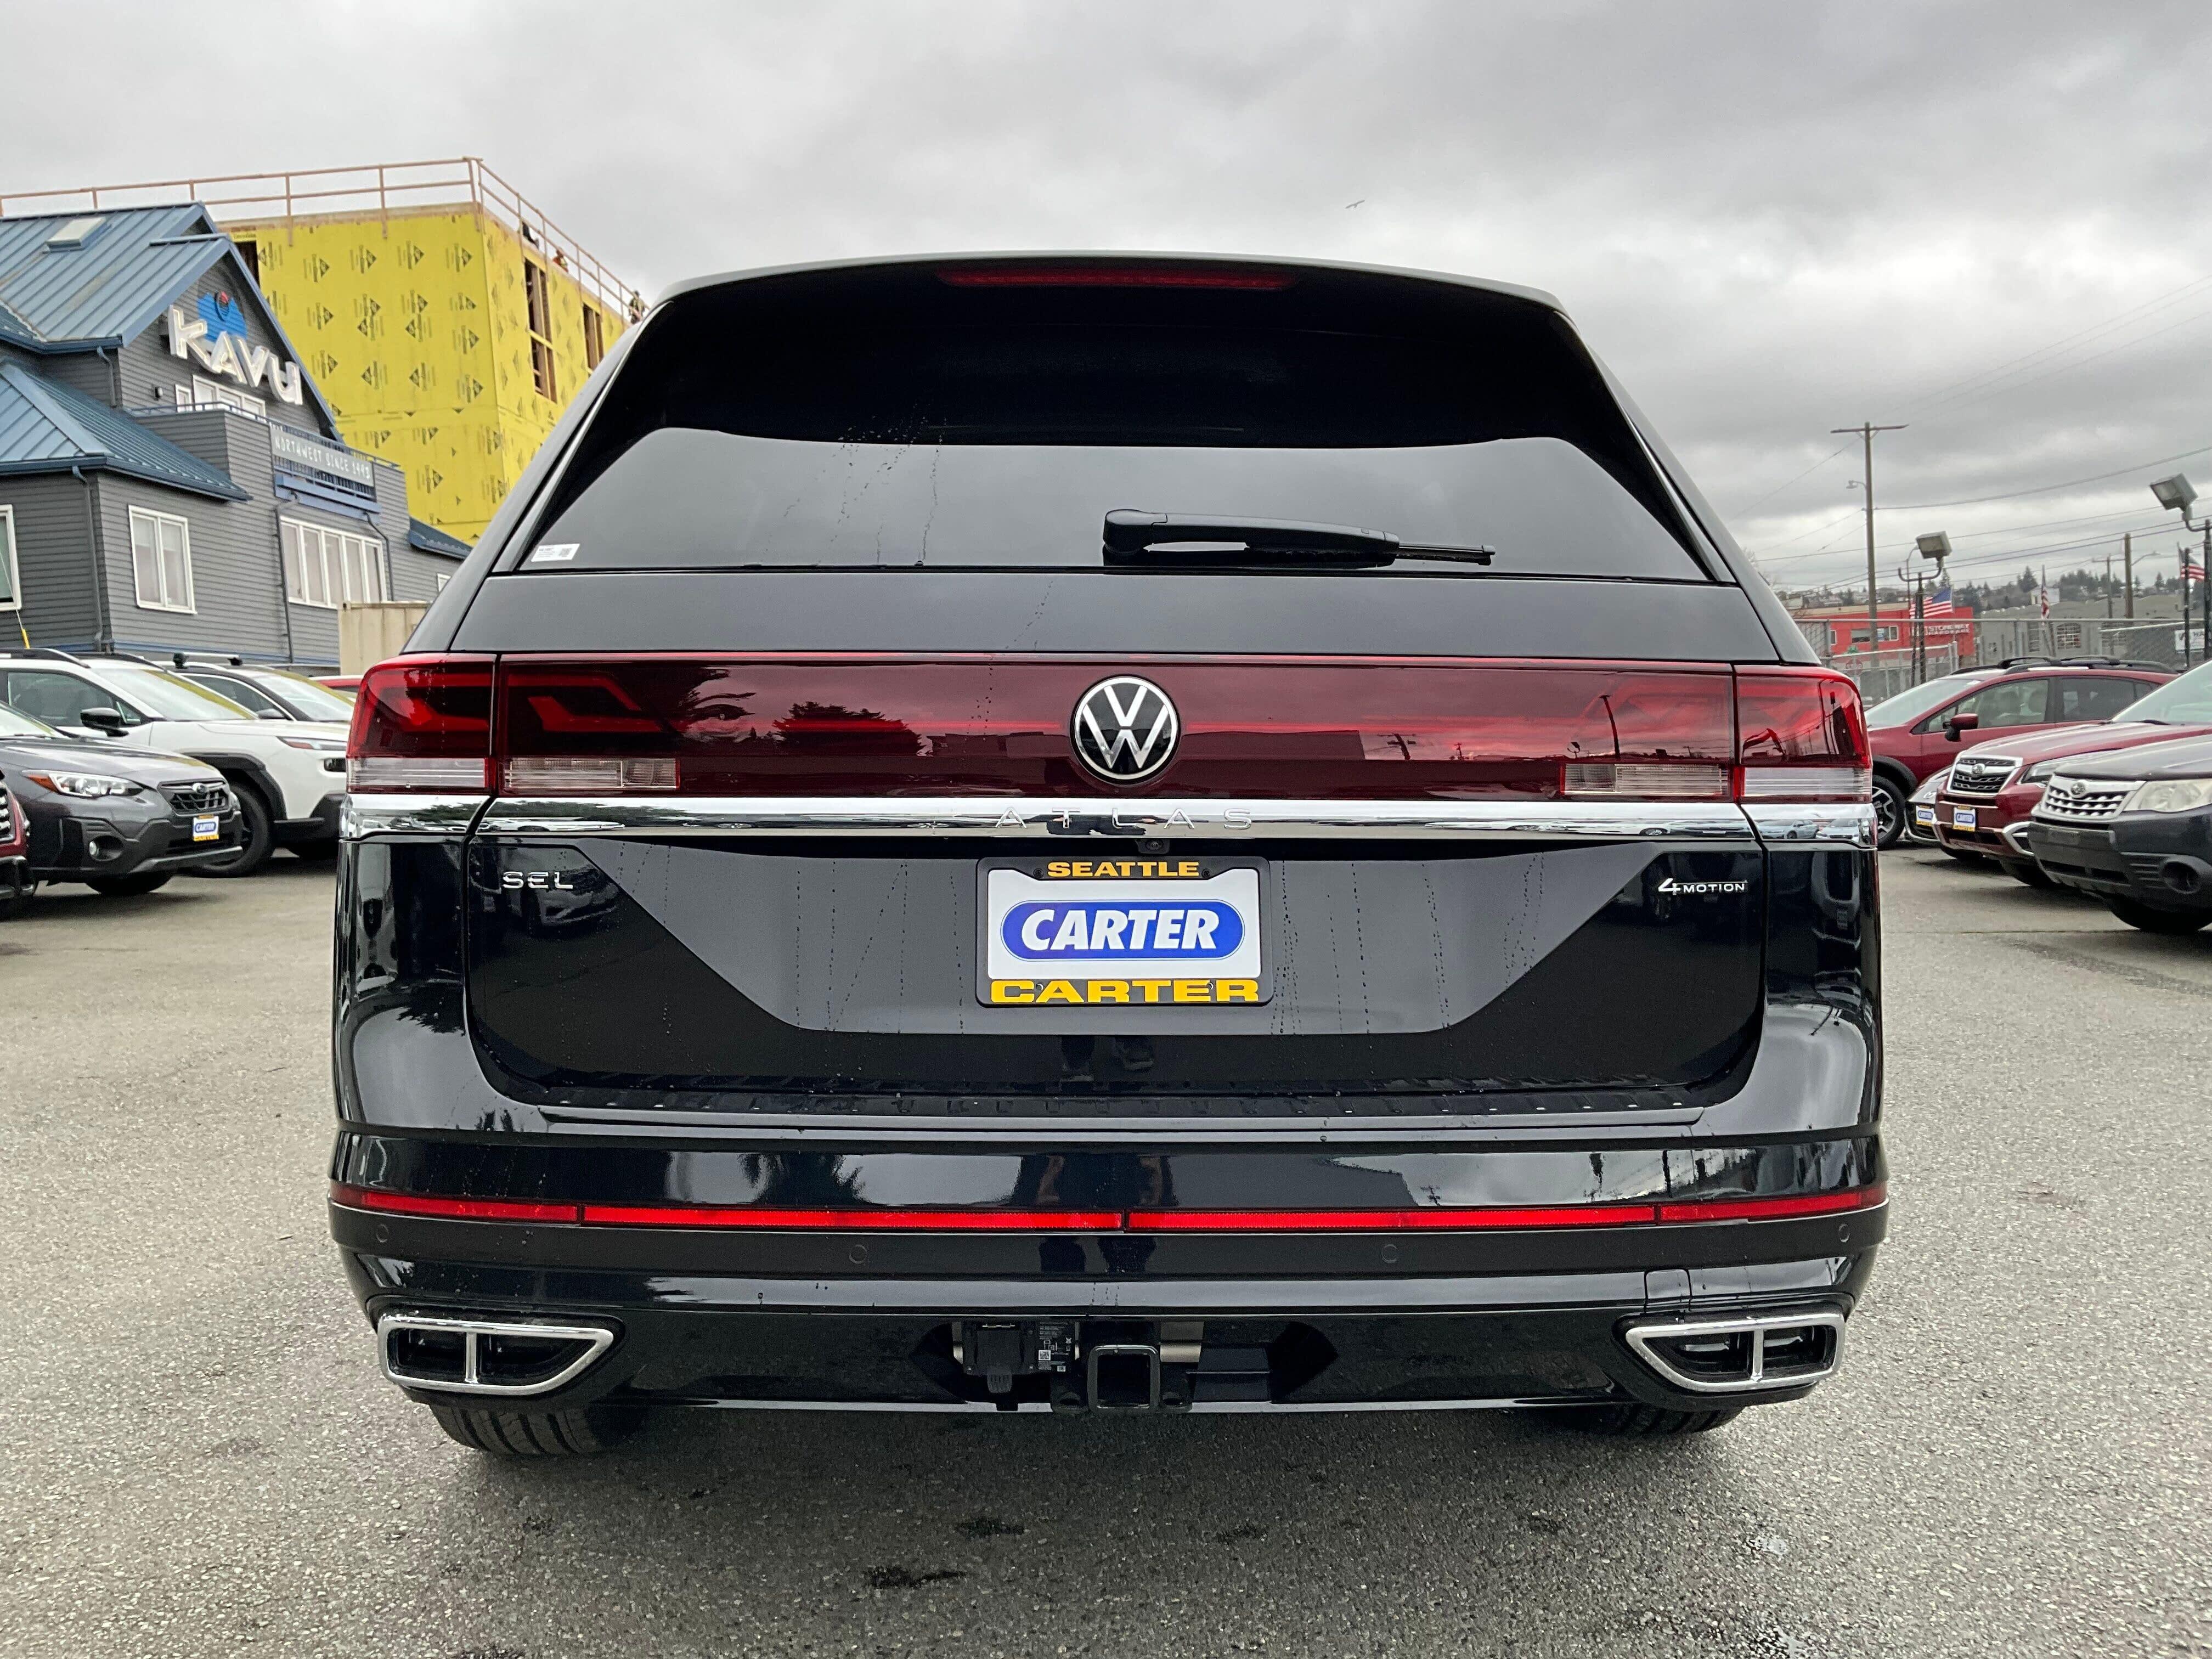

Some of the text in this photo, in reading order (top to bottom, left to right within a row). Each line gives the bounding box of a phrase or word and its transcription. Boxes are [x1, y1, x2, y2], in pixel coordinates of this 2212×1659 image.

[168, 304, 303, 405] KAVU
[275, 437, 321, 462] NORTHWEST
[326, 453, 349, 472] SINCE
[996, 808, 1252, 830] ATLAS
[502, 871, 573, 889] SEL
[1048, 861, 1200, 878] SEATTLE
[1658, 878, 1746, 896] 4MOTION
[1020, 909, 1220, 951] CARTER
[990, 979, 1259, 1003] CARTER
